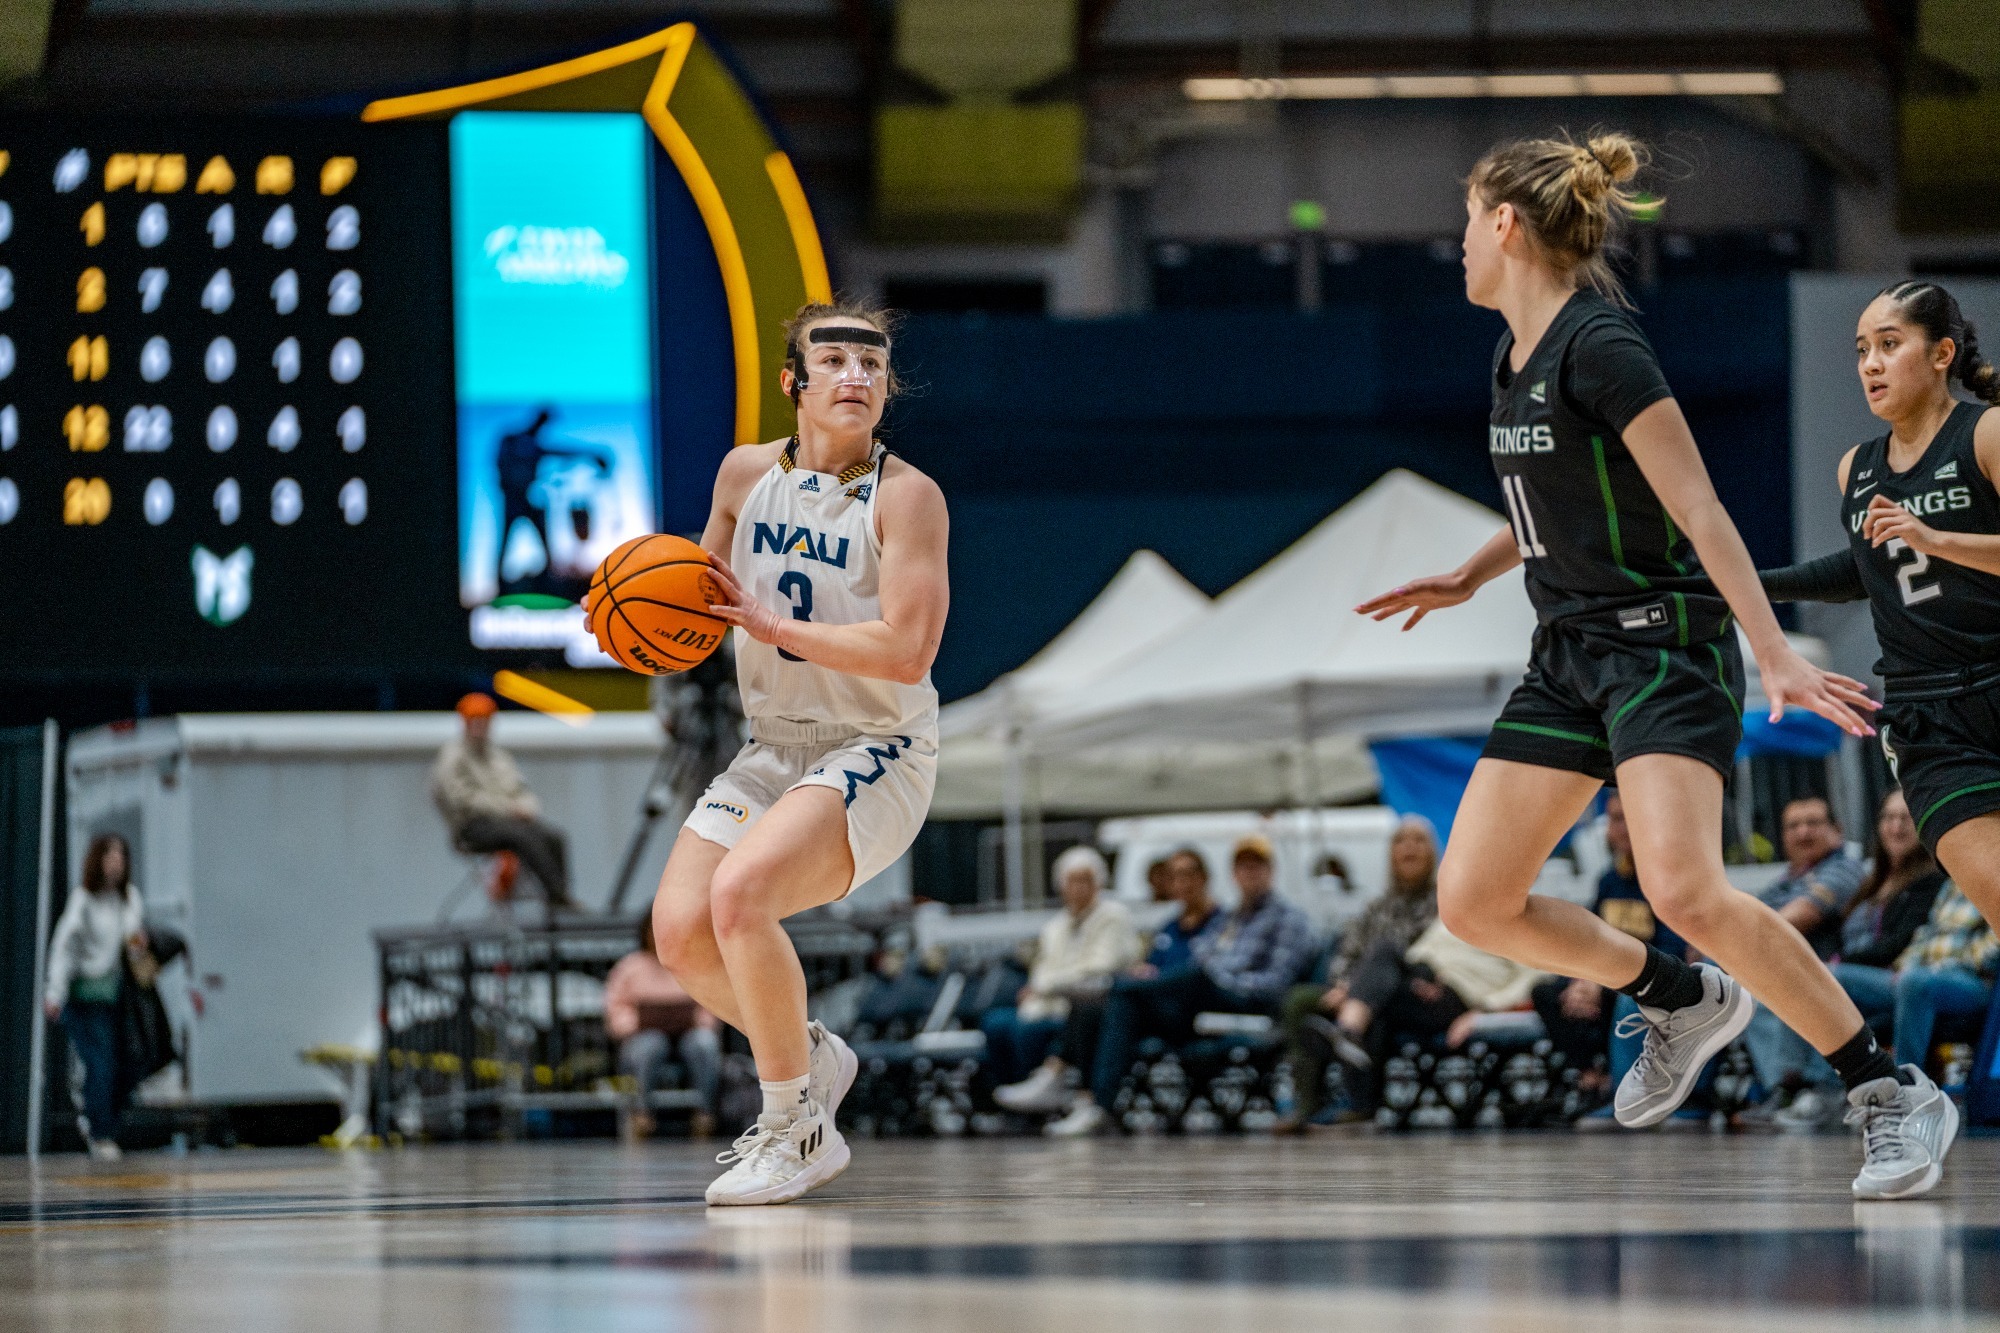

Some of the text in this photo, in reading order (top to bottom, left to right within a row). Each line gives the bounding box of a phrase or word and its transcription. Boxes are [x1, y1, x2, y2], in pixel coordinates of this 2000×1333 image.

[81, 202, 104, 245] 1
[208, 204, 234, 248] 1
[263, 205, 295, 248] 4
[327, 206, 359, 249] 2
[139, 269, 168, 312] 7
[202, 269, 233, 312] 4
[271, 270, 298, 313] 1
[329, 270, 361, 315] 2
[68, 336, 108, 380] 11
[273, 337, 299, 382] 1
[330, 338, 362, 382] 0
[268, 406, 300, 451] 4
[338, 407, 365, 451] 1
[144, 479, 173, 524] 0
[214, 479, 239, 524] 1
[340, 479, 367, 524] 1
[799, 483, 820, 493] adidas
[1851, 486, 1971, 533] VNGS
[1502, 475, 1548, 559] 11
[753, 522, 850, 570] NAU
[1887, 533, 1943, 608] 2
[777, 570, 813, 662] 3
[1651, 610, 1661, 621] M
[653, 627, 719, 651] EVO NXT
[706, 802, 744, 817] NAU
